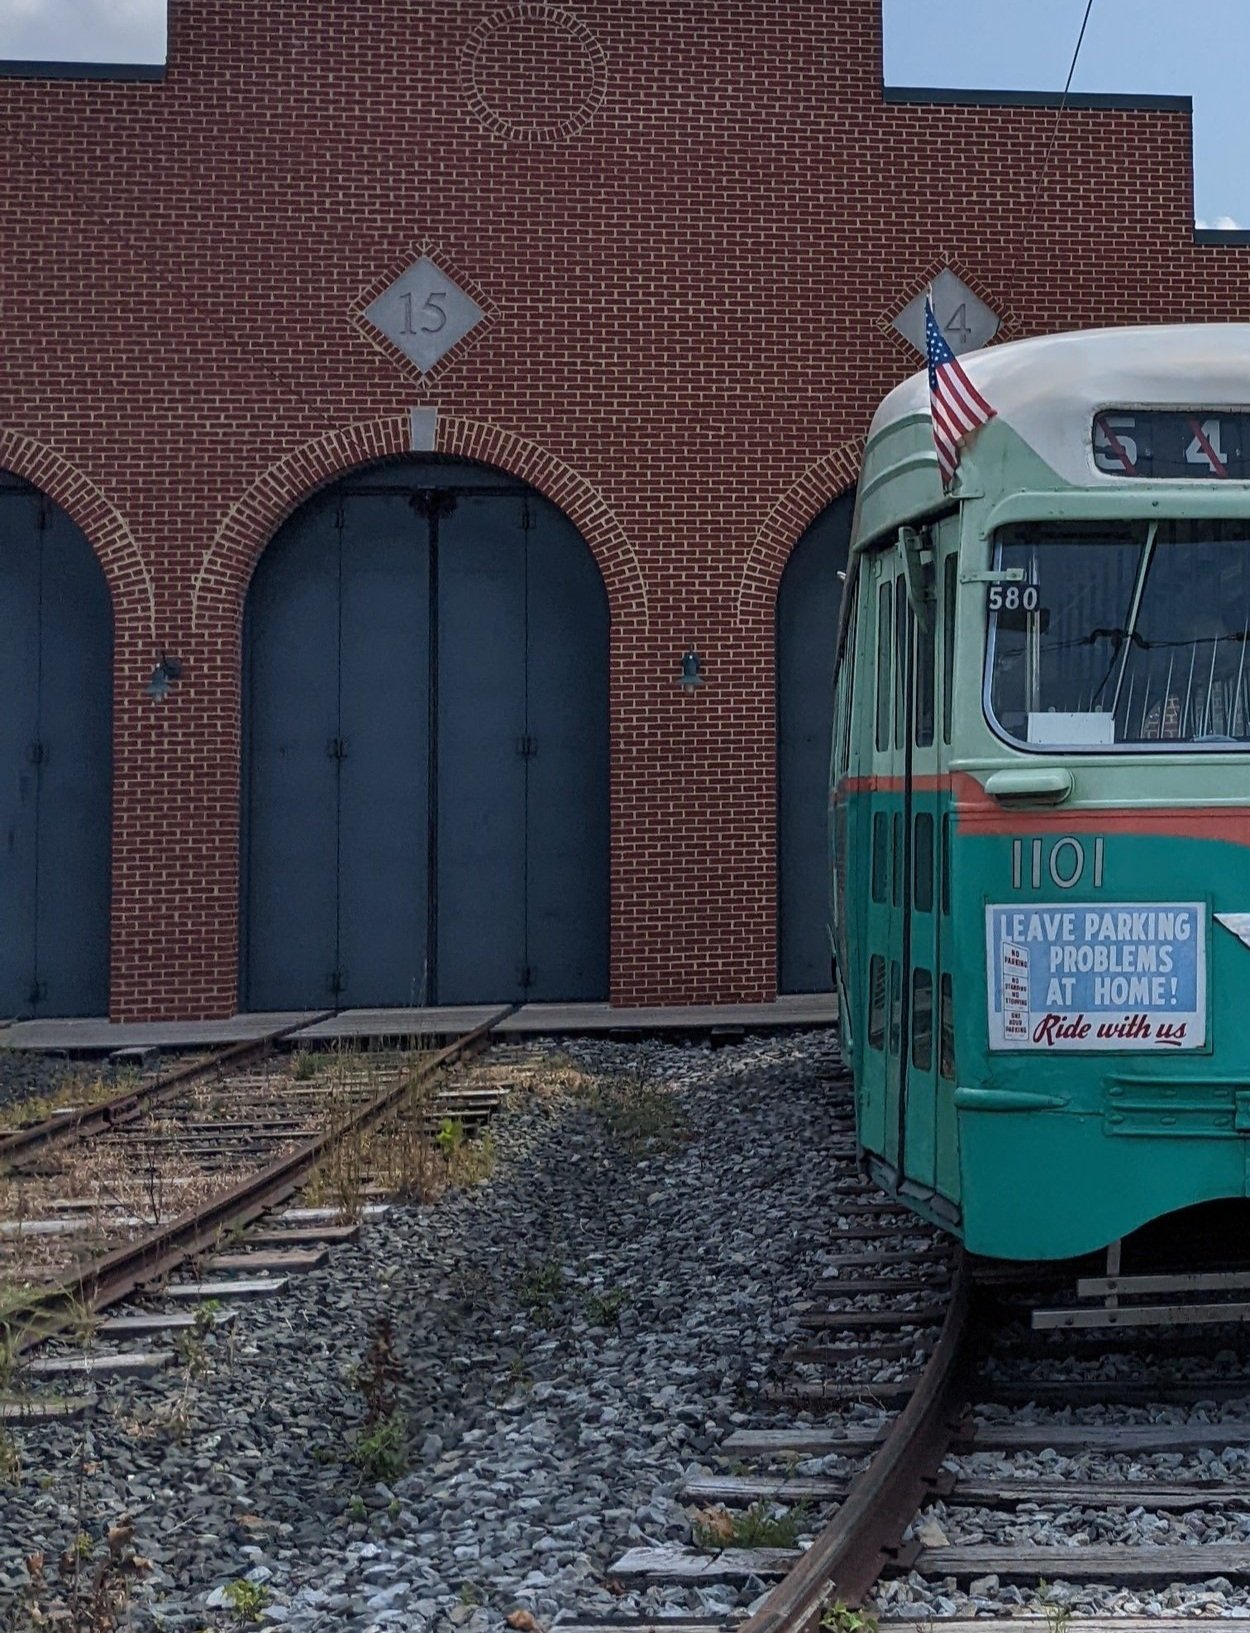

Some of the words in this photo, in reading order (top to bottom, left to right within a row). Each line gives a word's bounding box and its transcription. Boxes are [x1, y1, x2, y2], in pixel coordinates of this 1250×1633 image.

[399, 292, 447, 335] 15
[1095, 417, 1138, 470] 5
[1185, 420, 1228, 472] 4
[988, 586, 1038, 611] 580
[1012, 836, 1105, 889] 1101
[1001, 913, 1076, 942] LEAVE
[1085, 912, 1191, 941] PARKING
[1050, 945, 1174, 973] PROBLEMS
[1046, 977, 1077, 1006] AT
[1094, 977, 1179, 1005] HOME!
[1032, 1013, 1092, 1046] Ride
[1097, 1014, 1152, 1039] with
[1155, 1022, 1187, 1040] us
